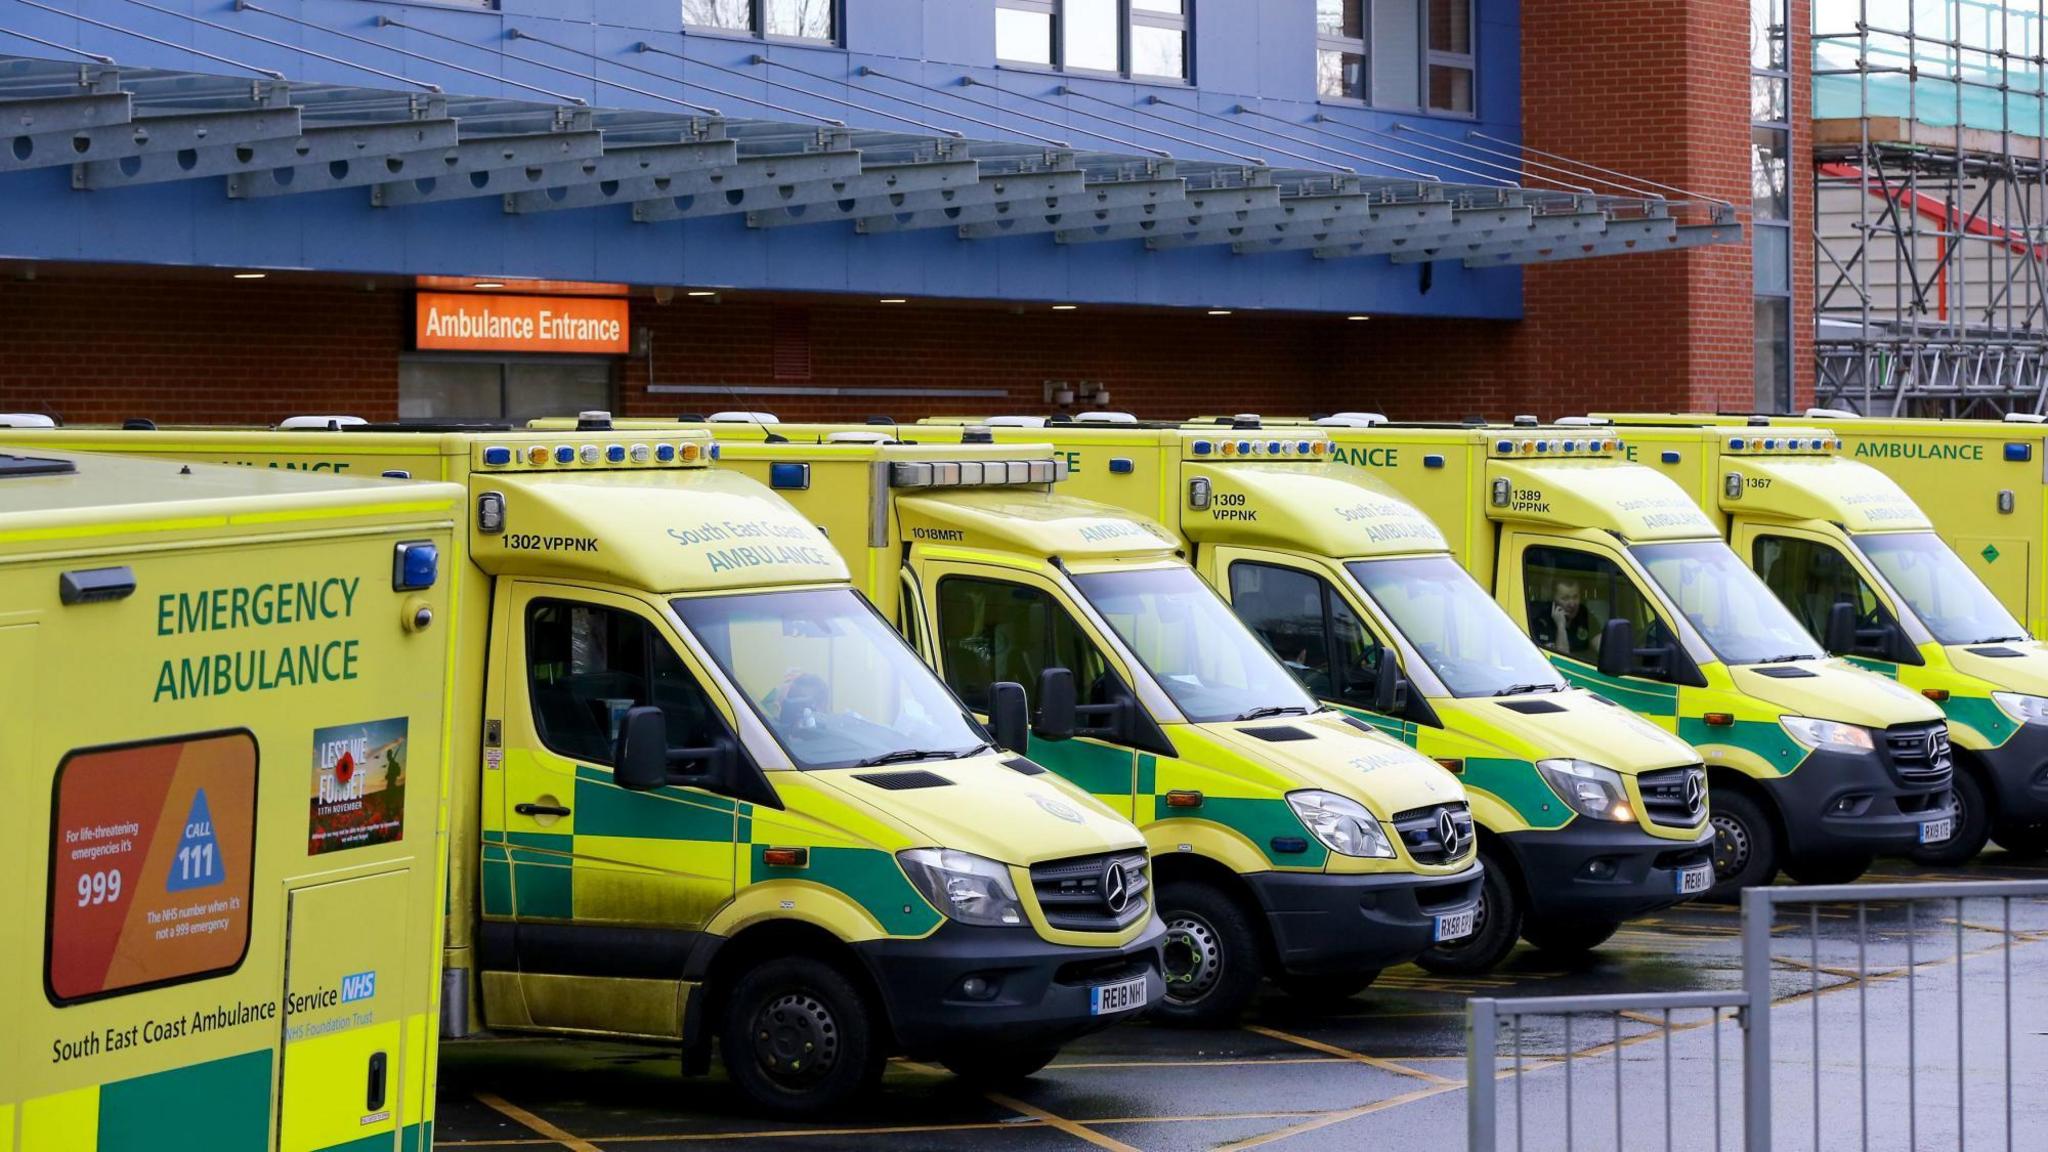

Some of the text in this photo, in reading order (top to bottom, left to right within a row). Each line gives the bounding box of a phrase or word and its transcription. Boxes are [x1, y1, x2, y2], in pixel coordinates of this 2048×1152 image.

[425, 307, 621, 341] Ambulance Entrance
[1855, 442, 1984, 460] AMBULANCE
[1513, 489, 1541, 501] 1389
[1745, 478, 1772, 489] 1367
[1212, 494, 1245, 506] 1309
[1511, 502, 1551, 513] VPPNK
[1212, 510, 1257, 521] VPPNK
[667, 523, 730, 546] South
[723, 521, 768, 538] East
[911, 527, 964, 542] 1018MRT
[706, 546, 830, 573] AMBULANCE
[157, 577, 360, 636] EMERGENCY
[153, 640, 360, 702] AMBULANCE
[321, 737, 367, 769] LEST WE
[318, 801, 362, 816] 11TH NOVEMBER
[66, 821, 138, 843] For life-threatening
[186, 822, 210, 838] CALL
[71, 839, 132, 860] emergencies it's
[179, 843, 213, 880] 111
[78, 868, 122, 907] 999
[147, 911, 161, 924] The
[162, 907, 178, 921] NHS
[179, 904, 207, 918] number
[207, 900, 228, 914] when
[156, 918, 230, 941] not a 999 emergency
[1441, 916, 1461, 937] RX58
[1103, 981, 1145, 1009] RE18 NHT
[52, 971, 375, 1063] South East Coast Ambulance Service NHS
[305, 1016, 351, 1036] Foundation
[353, 1010, 373, 1026] Trust
